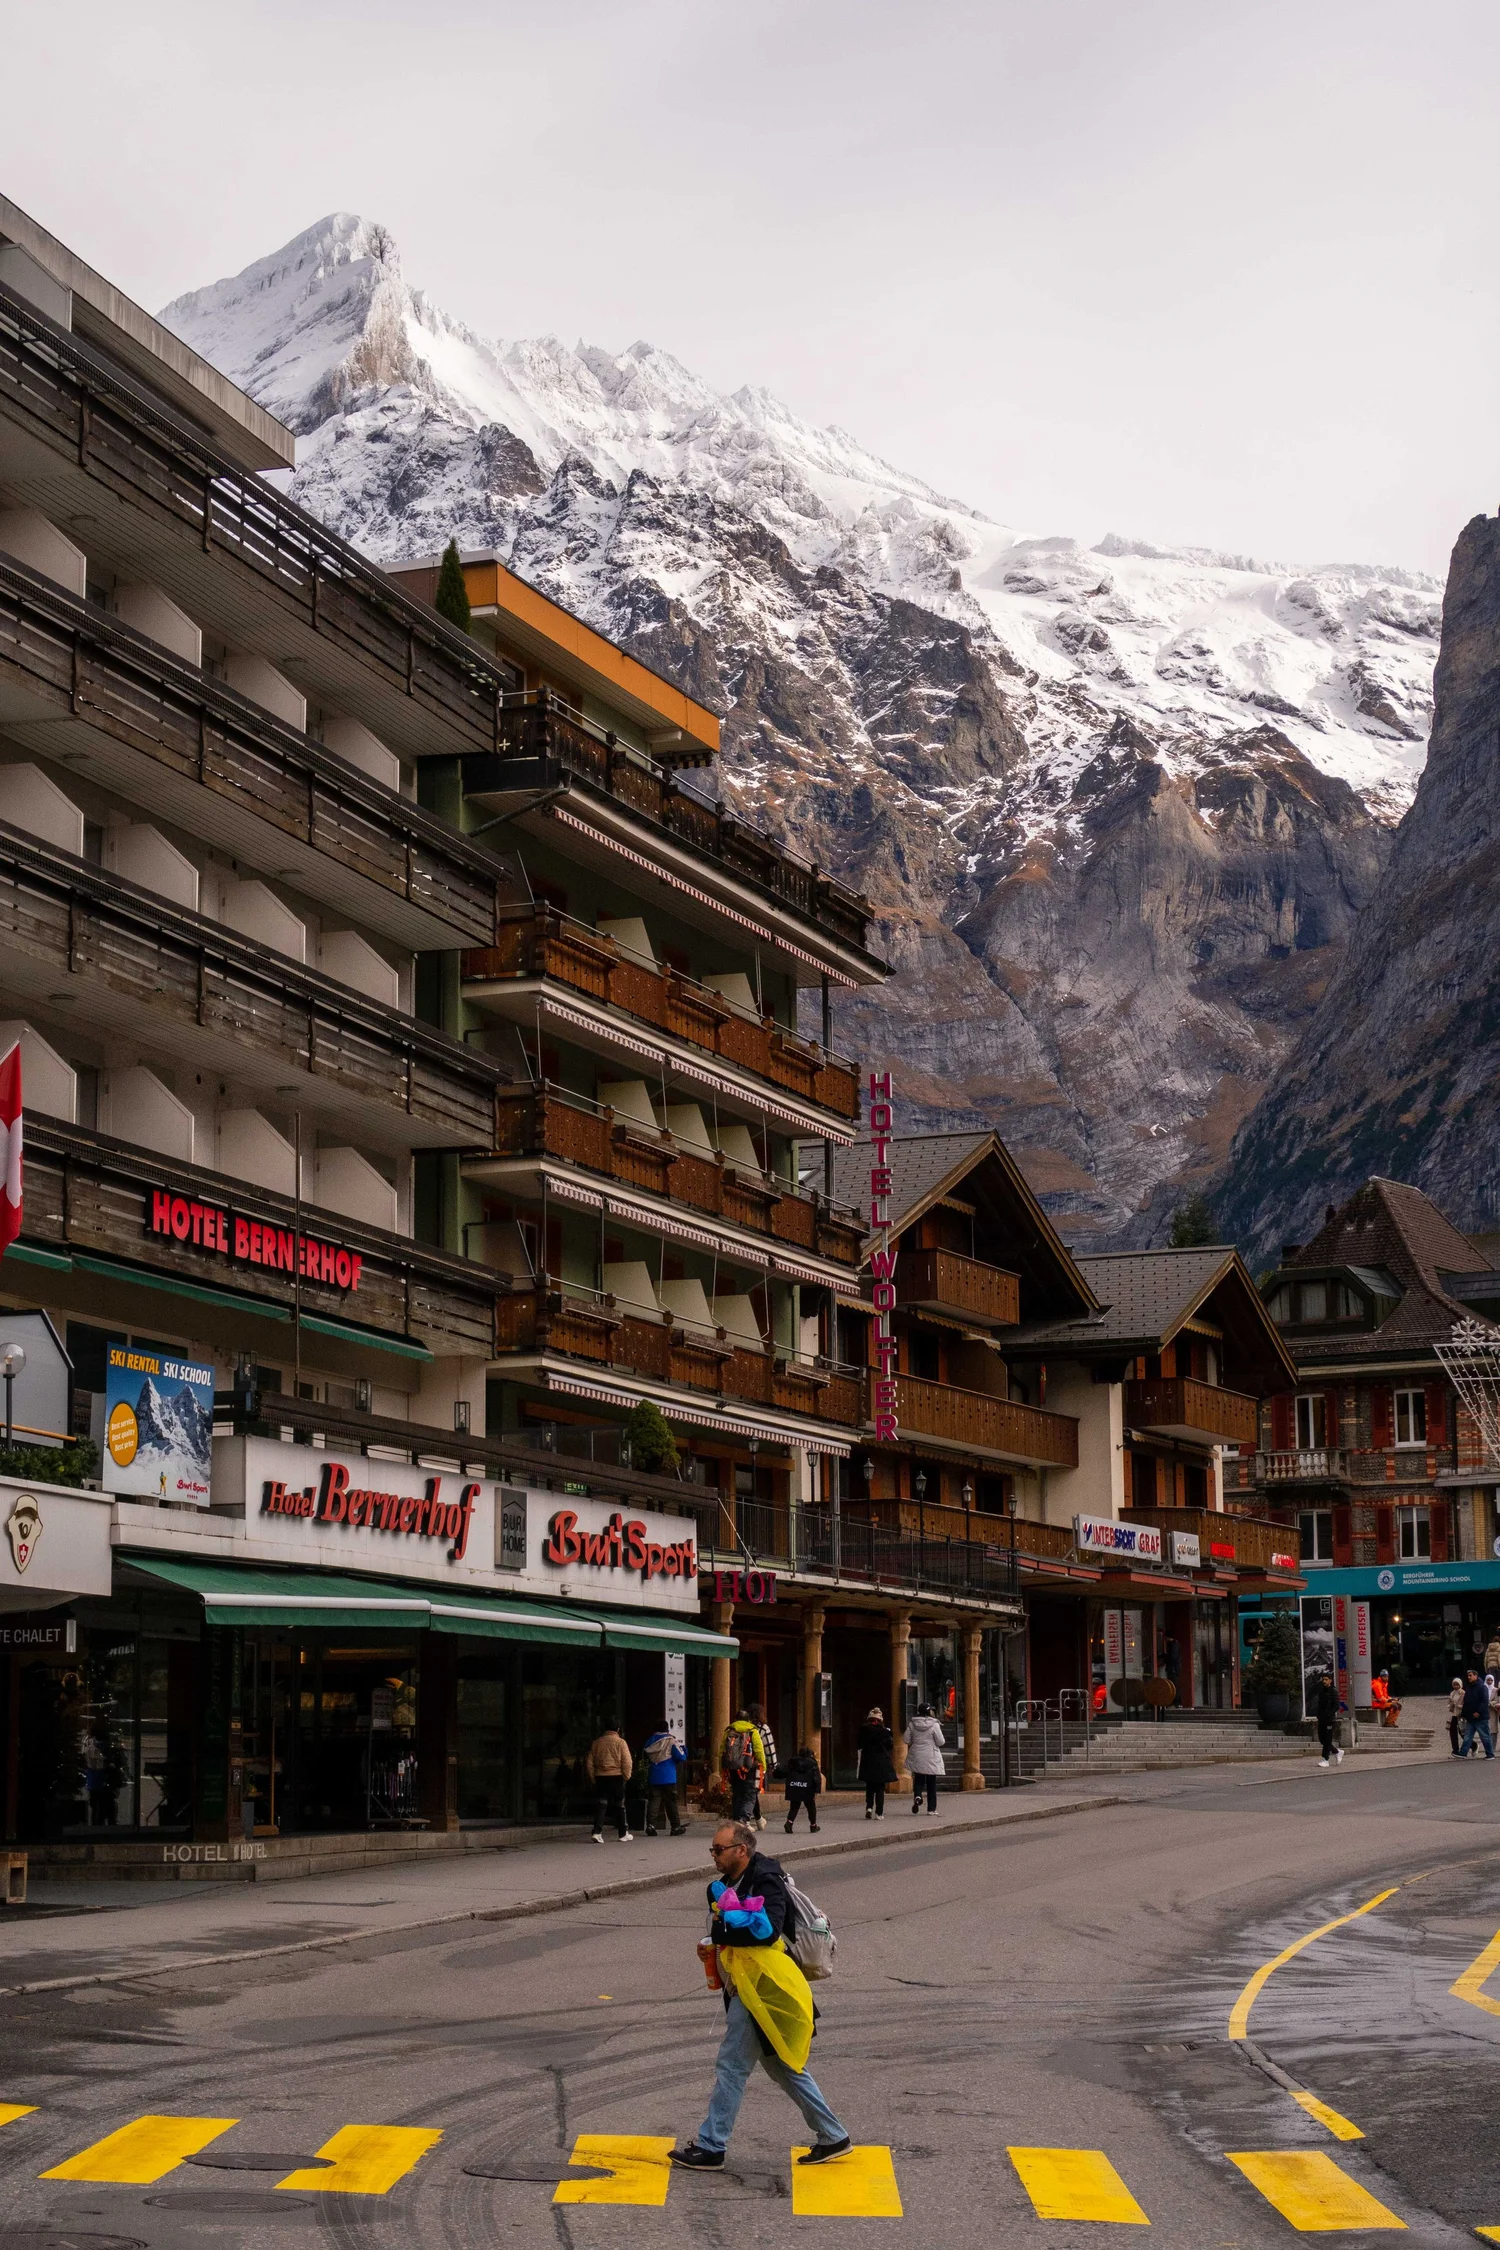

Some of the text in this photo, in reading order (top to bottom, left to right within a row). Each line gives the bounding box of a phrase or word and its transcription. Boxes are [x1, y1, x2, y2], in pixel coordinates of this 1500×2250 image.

[152, 1190, 363, 1292] HOTEL BERNERHOF
[869, 1072, 899, 1441] HOTEL WOLTER
[109, 1349, 212, 1387] SKI RENTAL SKI SCHOOL
[111, 1418, 134, 1430] Best service
[112, 1429, 135, 1441] Best quality
[115, 1444, 124, 1452] Best
[265, 1462, 481, 1560] Hotel Bernerhof
[503, 1513, 526, 1533] BURI
[503, 1535, 526, 1554] HOME
[1092, 1524, 1136, 1551] INTERSPORT
[1138, 1532, 1160, 1555] GRAF
[622, 1519, 698, 1581] Sport
[1402, 1575, 1471, 1585] MOUNTAINEERING SCHOOL
[1335, 1597, 1346, 1632] GRAF
[13, 1628, 61, 1643] CHALET
[1357, 1606, 1367, 1656] RAIFFEISEN
[163, 1845, 228, 1862] HOTEL
[240, 1843, 267, 1860] HOTEL
